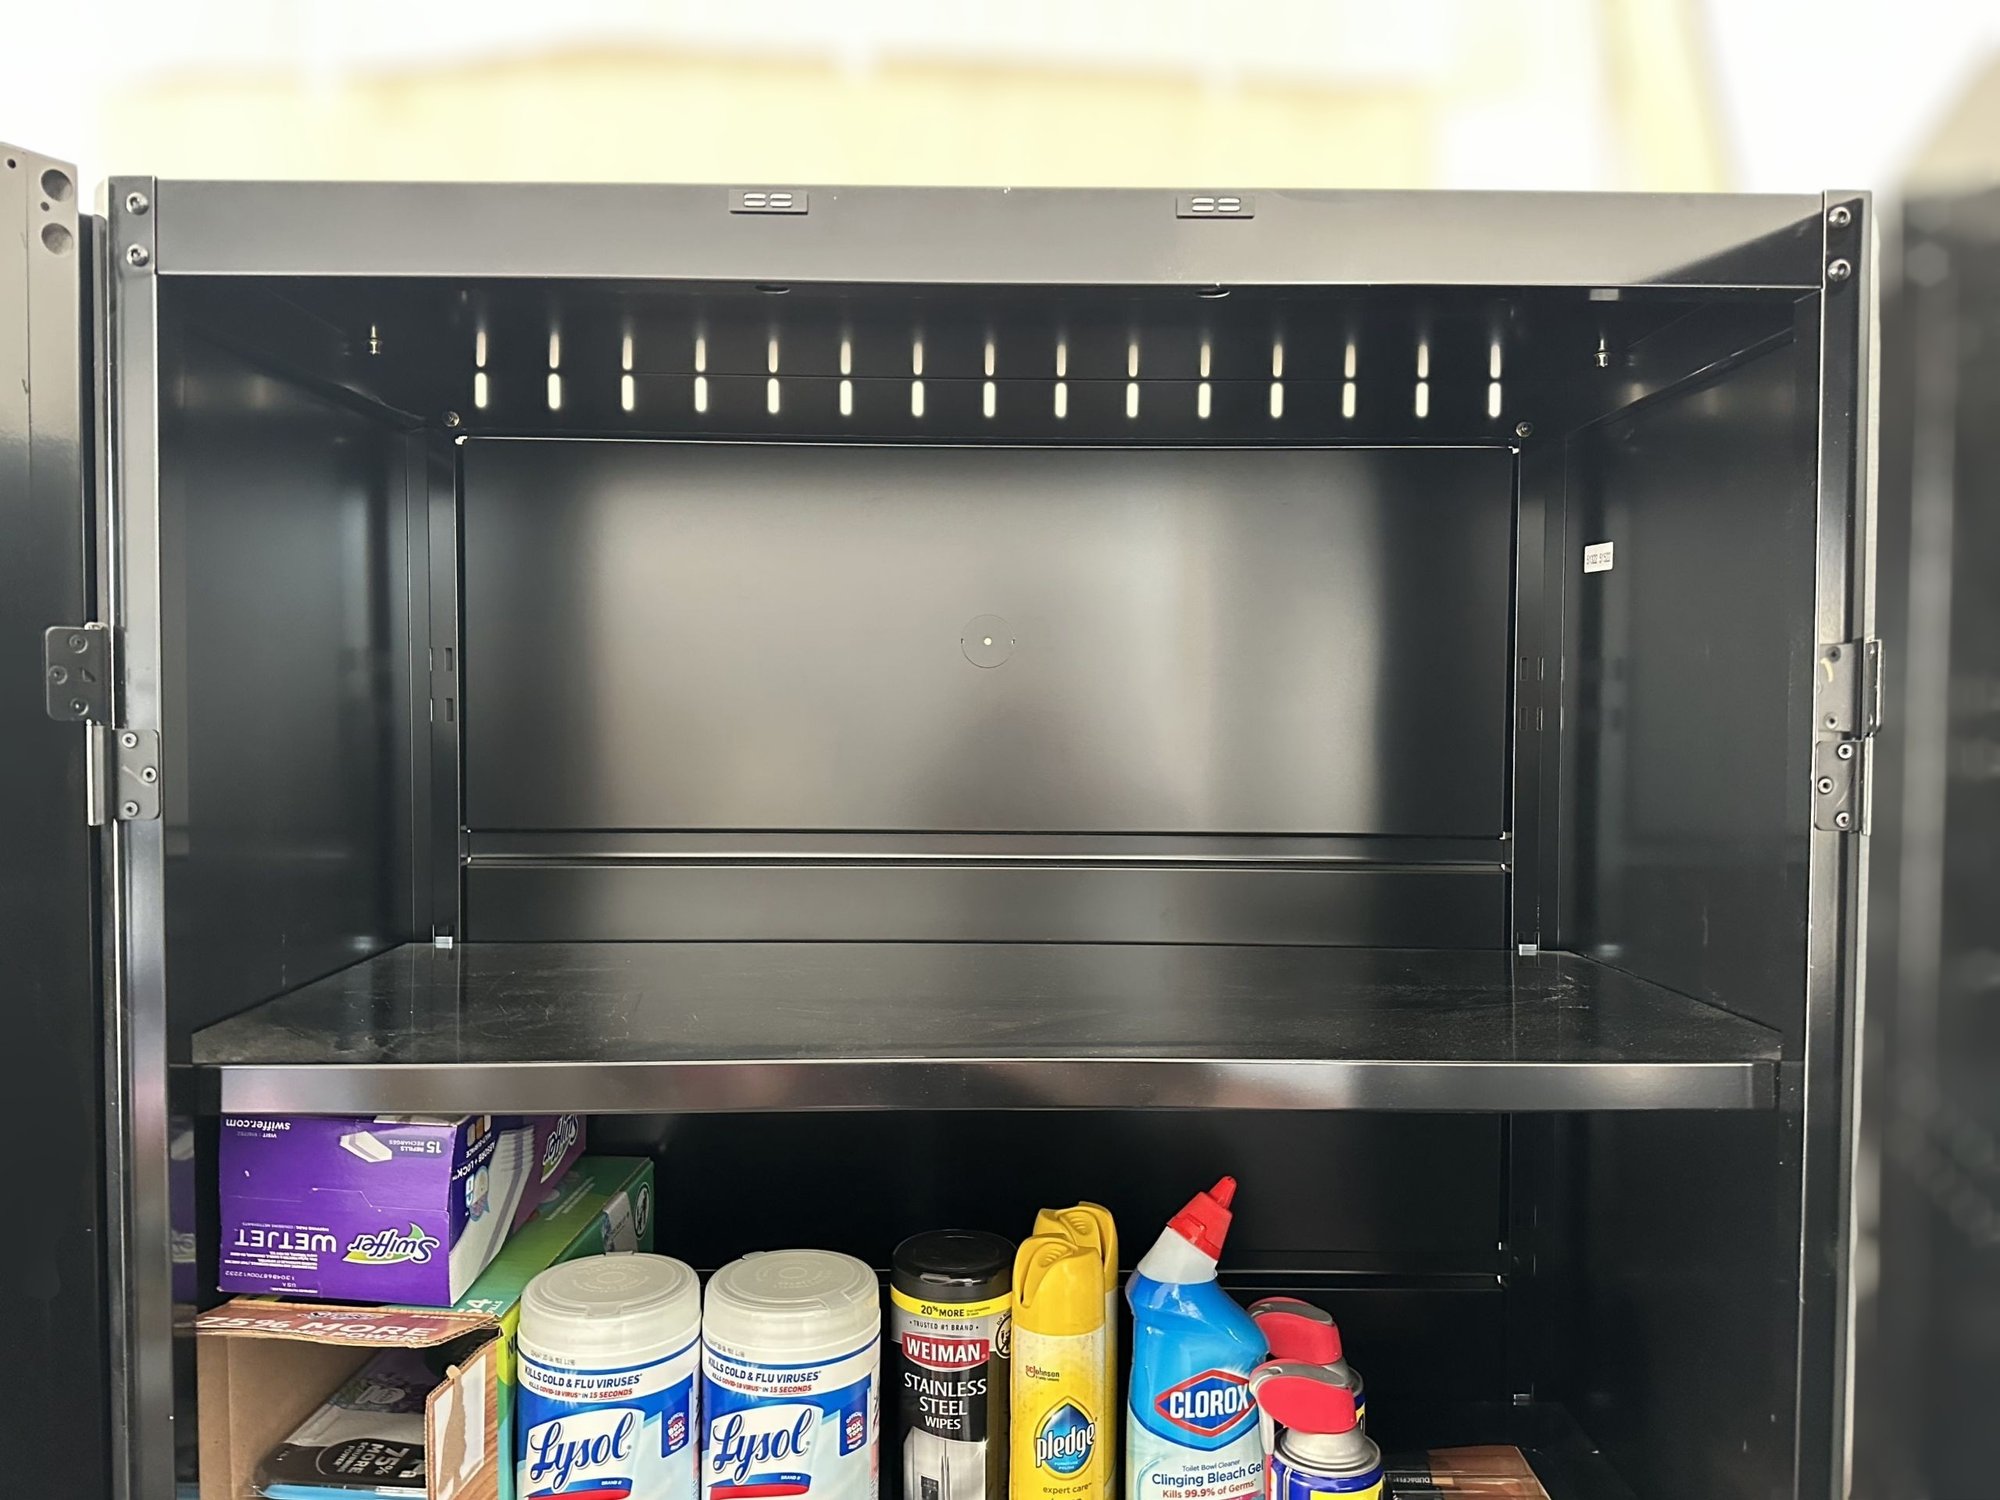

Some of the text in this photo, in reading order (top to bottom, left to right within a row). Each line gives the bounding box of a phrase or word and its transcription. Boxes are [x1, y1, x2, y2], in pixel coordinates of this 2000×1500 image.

[225, 1119, 291, 1132] swiffer.com
[426, 1141, 442, 1153] 15
[234, 1229, 337, 1253] WETJET
[347, 1229, 439, 1263] Swiffer
[939, 1309, 965, 1317] MORE
[198, 1317, 294, 1328] 75%
[299, 1322, 438, 1336] MORE
[913, 1320, 938, 1330] TRUSTED
[906, 1337, 981, 1363] WEIMAN
[525, 1365, 541, 1381] KILLS
[542, 1374, 565, 1387] COLD
[566, 1378, 572, 1388] &
[574, 1379, 594, 1389] FLU
[708, 1356, 724, 1373] KILLS
[724, 1366, 746, 1379] COLD
[747, 1372, 754, 1381] &
[755, 1373, 775, 1383] FLU
[589, 1391, 598, 1399] 15
[599, 1388, 633, 1399] SECONDS
[779, 1385, 812, 1393] SECONDS
[904, 1372, 987, 1397] STAINLESS
[919, 1396, 968, 1415] STEEL
[1169, 1383, 1249, 1418] CLOROX
[925, 1415, 961, 1429] WIPES
[530, 1411, 633, 1490] Lysol
[713, 1408, 812, 1482] Lysol
[1036, 1423, 1095, 1468] pledge
[347, 1443, 384, 1473] MORE
[1218, 1460, 1240, 1468] Cleaner
[1152, 1460, 1264, 1488] Clinging Bleach Gel
[1043, 1486, 1071, 1494] expert
[1162, 1490, 1182, 1499] Kills
[1184, 1488, 1216, 1498] 99.9%
[1217, 1486, 1227, 1494] of
